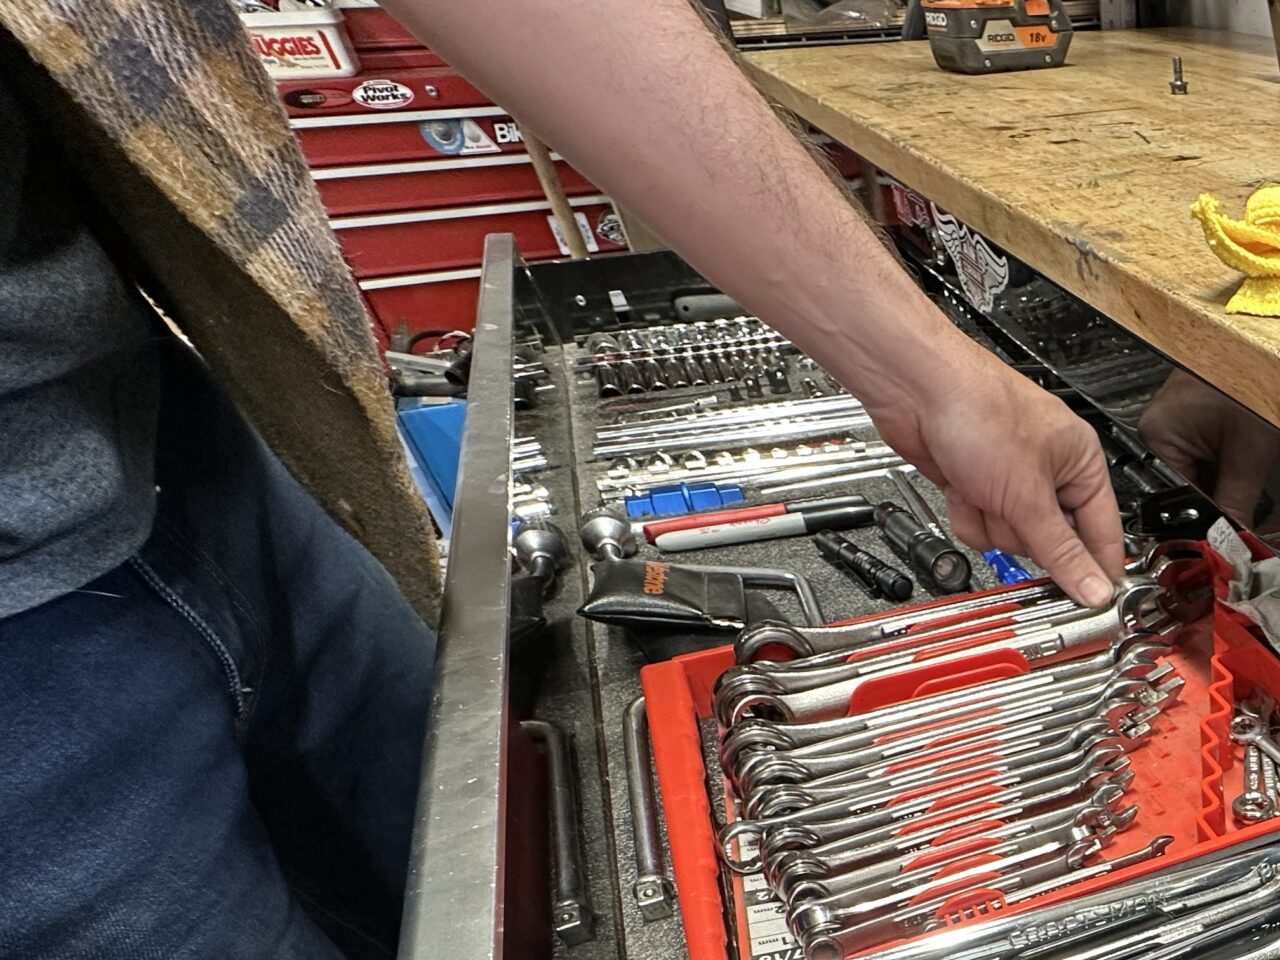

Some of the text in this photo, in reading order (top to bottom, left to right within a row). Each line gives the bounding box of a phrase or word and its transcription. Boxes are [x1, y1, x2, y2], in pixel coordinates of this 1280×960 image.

[987, 33, 1016, 43] RIDGID
[251, 34, 322, 57] UGGIES
[363, 84, 400, 94] Pivot
[360, 92, 409, 103] Works
